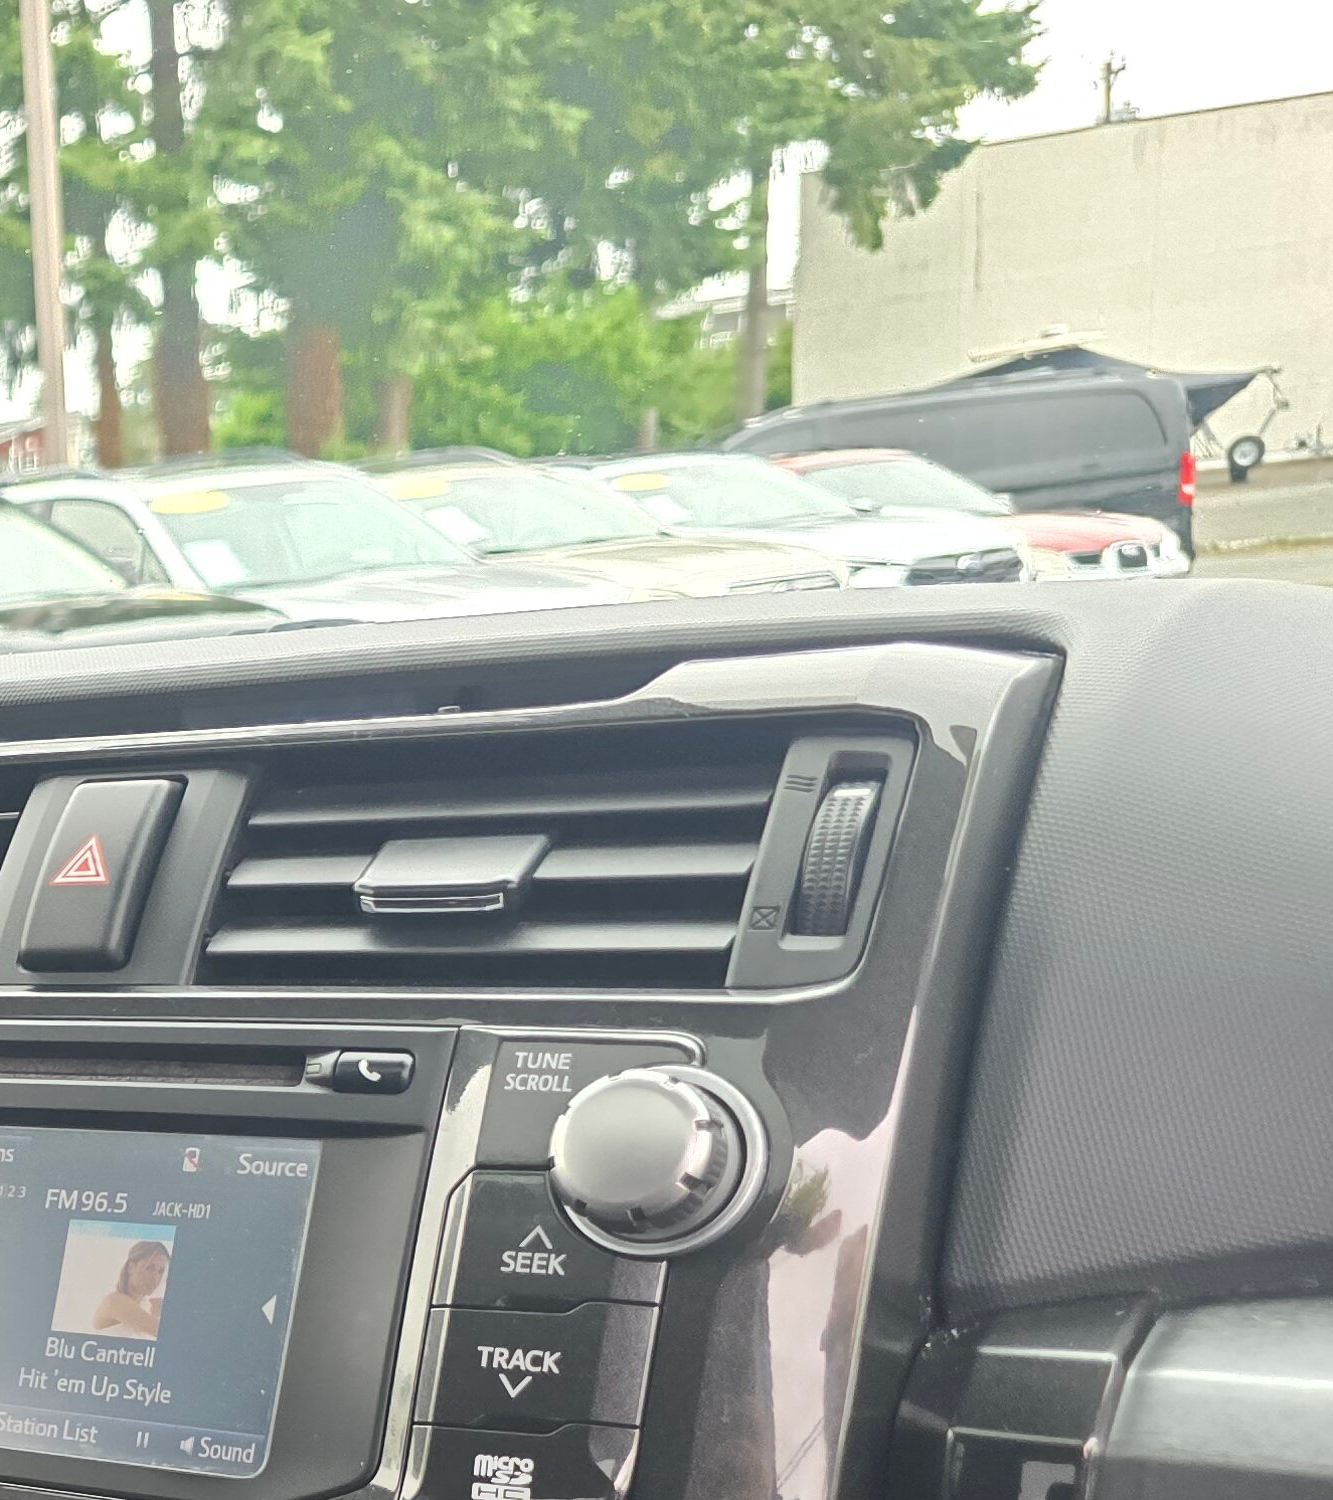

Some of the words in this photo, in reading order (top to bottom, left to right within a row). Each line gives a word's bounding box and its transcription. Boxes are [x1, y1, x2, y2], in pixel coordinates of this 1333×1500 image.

[515, 1052, 573, 1070] TUNE
[503, 1074, 573, 1093] SCROLL
[237, 1153, 309, 1177] Source
[152, 1201, 211, 1219] JACK-HD1
[501, 1251, 566, 1276] SEEK
[45, 1337, 75, 1359] Blu
[82, 1341, 156, 1368] Cantrell
[477, 1346, 562, 1374] TRACK
[19, 1367, 48, 1389] Hit
[54, 1369, 85, 1395] 'em
[91, 1375, 120, 1402] Up
[123, 1379, 172, 1406] Style
[62, 1420, 98, 1444] List
[198, 1436, 256, 1463] Sound
